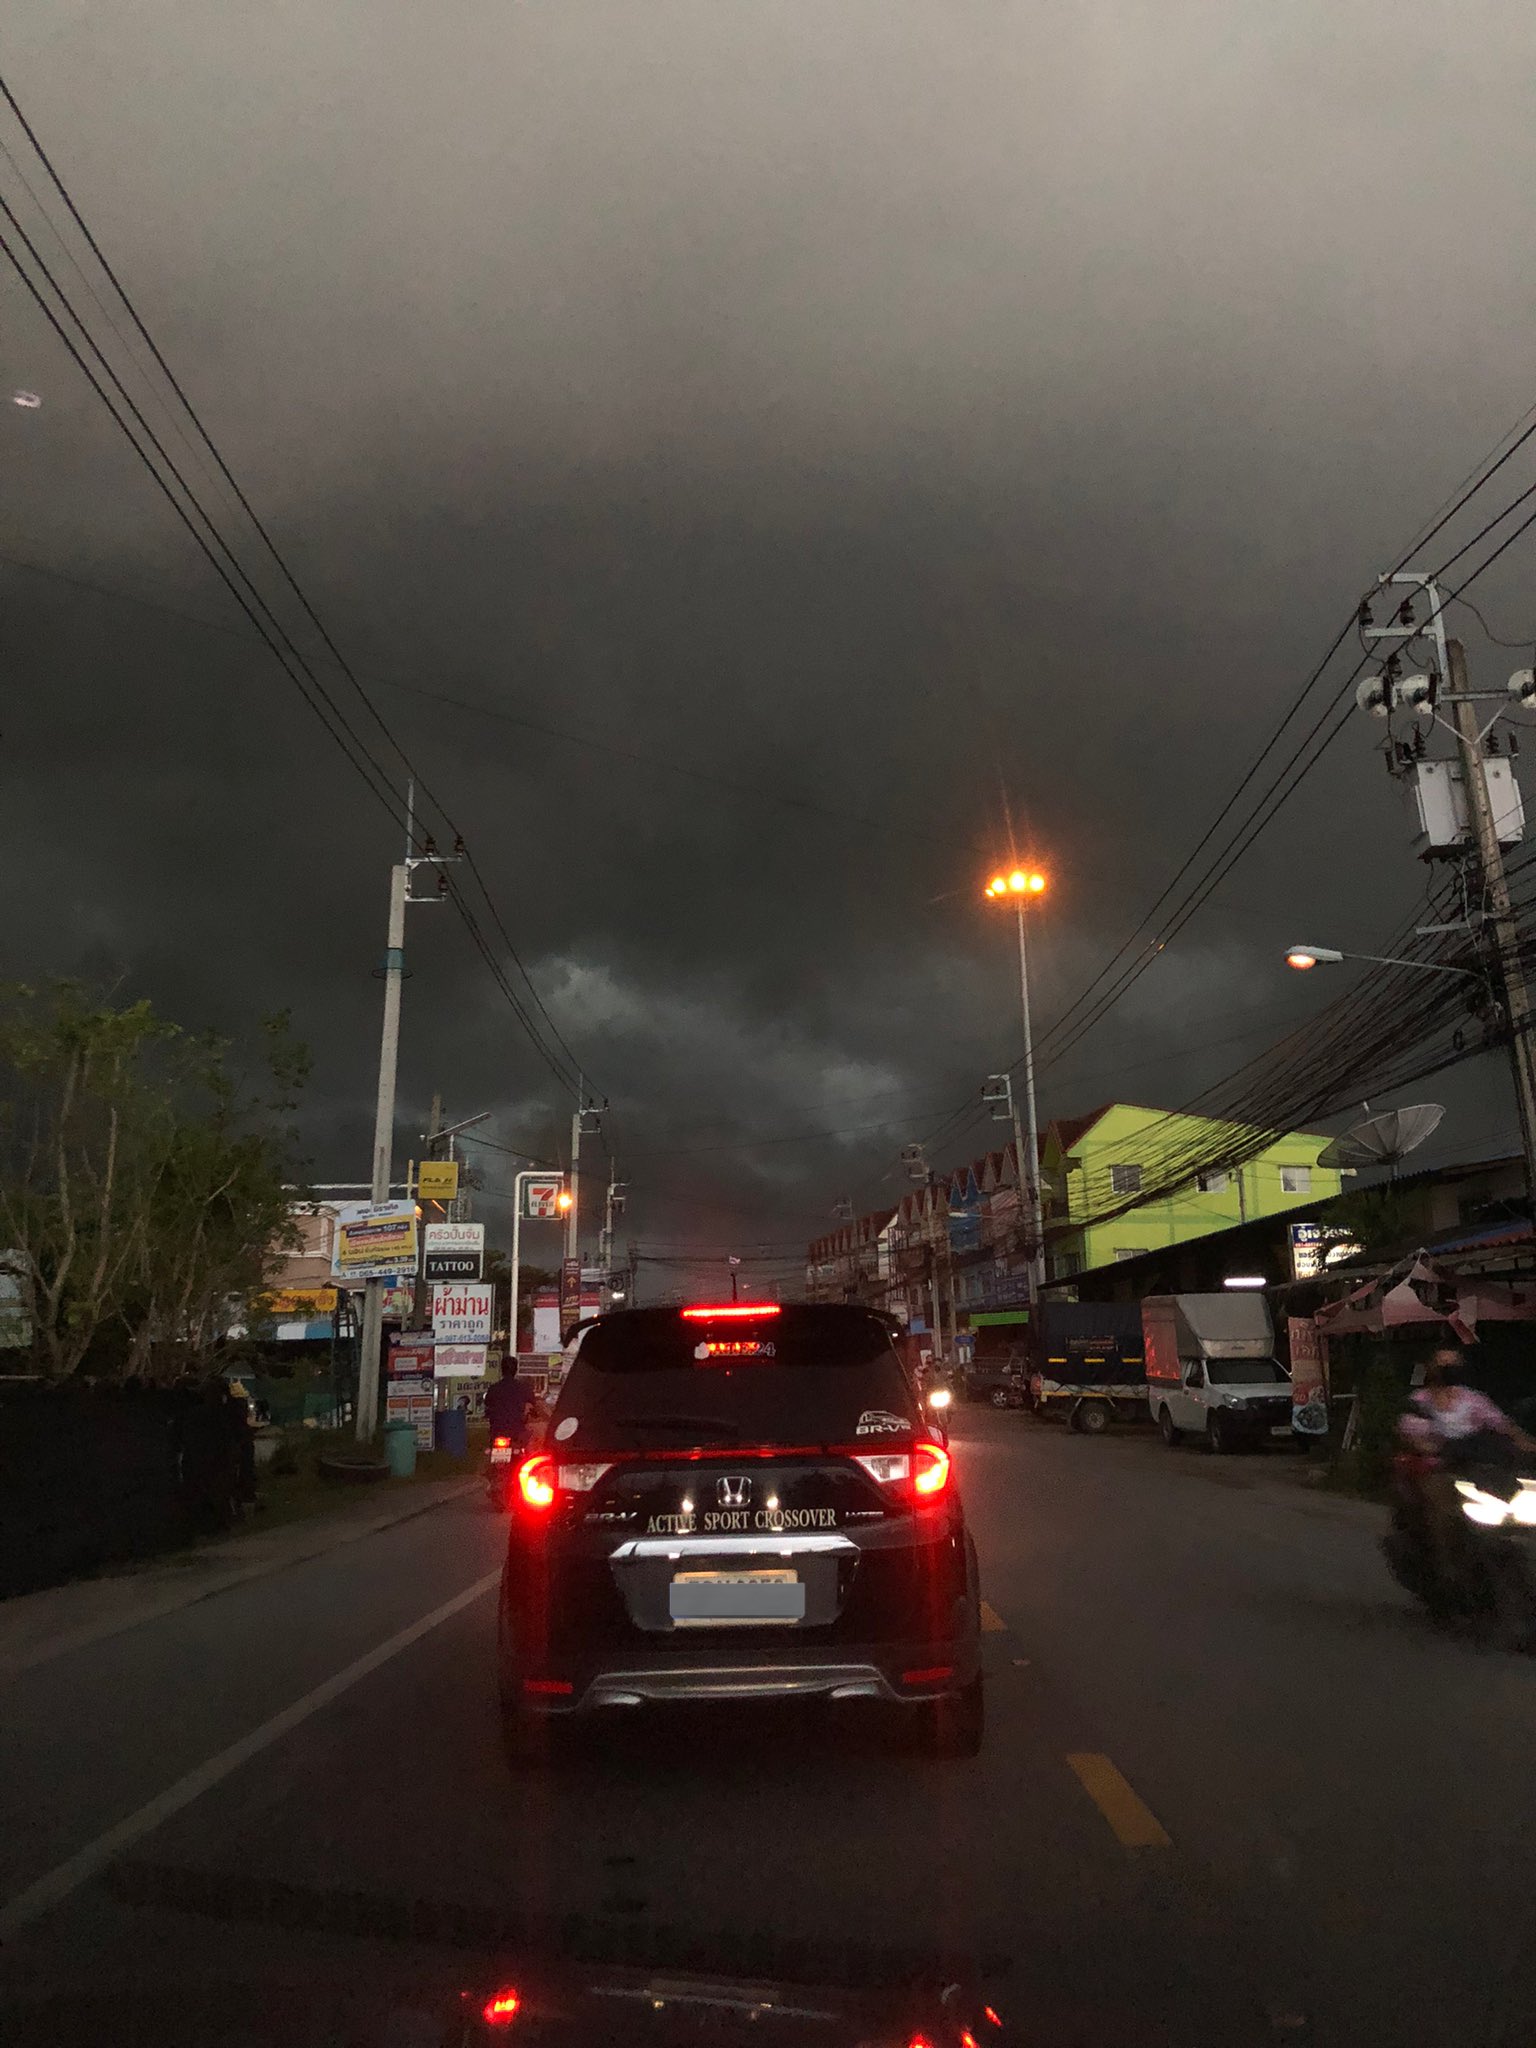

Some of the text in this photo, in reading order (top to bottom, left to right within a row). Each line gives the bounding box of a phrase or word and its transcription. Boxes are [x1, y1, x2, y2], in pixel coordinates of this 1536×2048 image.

[532, 1188, 554, 1216] 7
[429, 1261, 474, 1272] TATTOO
[434, 1287, 489, 1316] ผ้าม่าน
[439, 1319, 484, 1333] ราคาถูก
[646, 1508, 837, 1533] ACTIVE SPORT CROSSOVER
